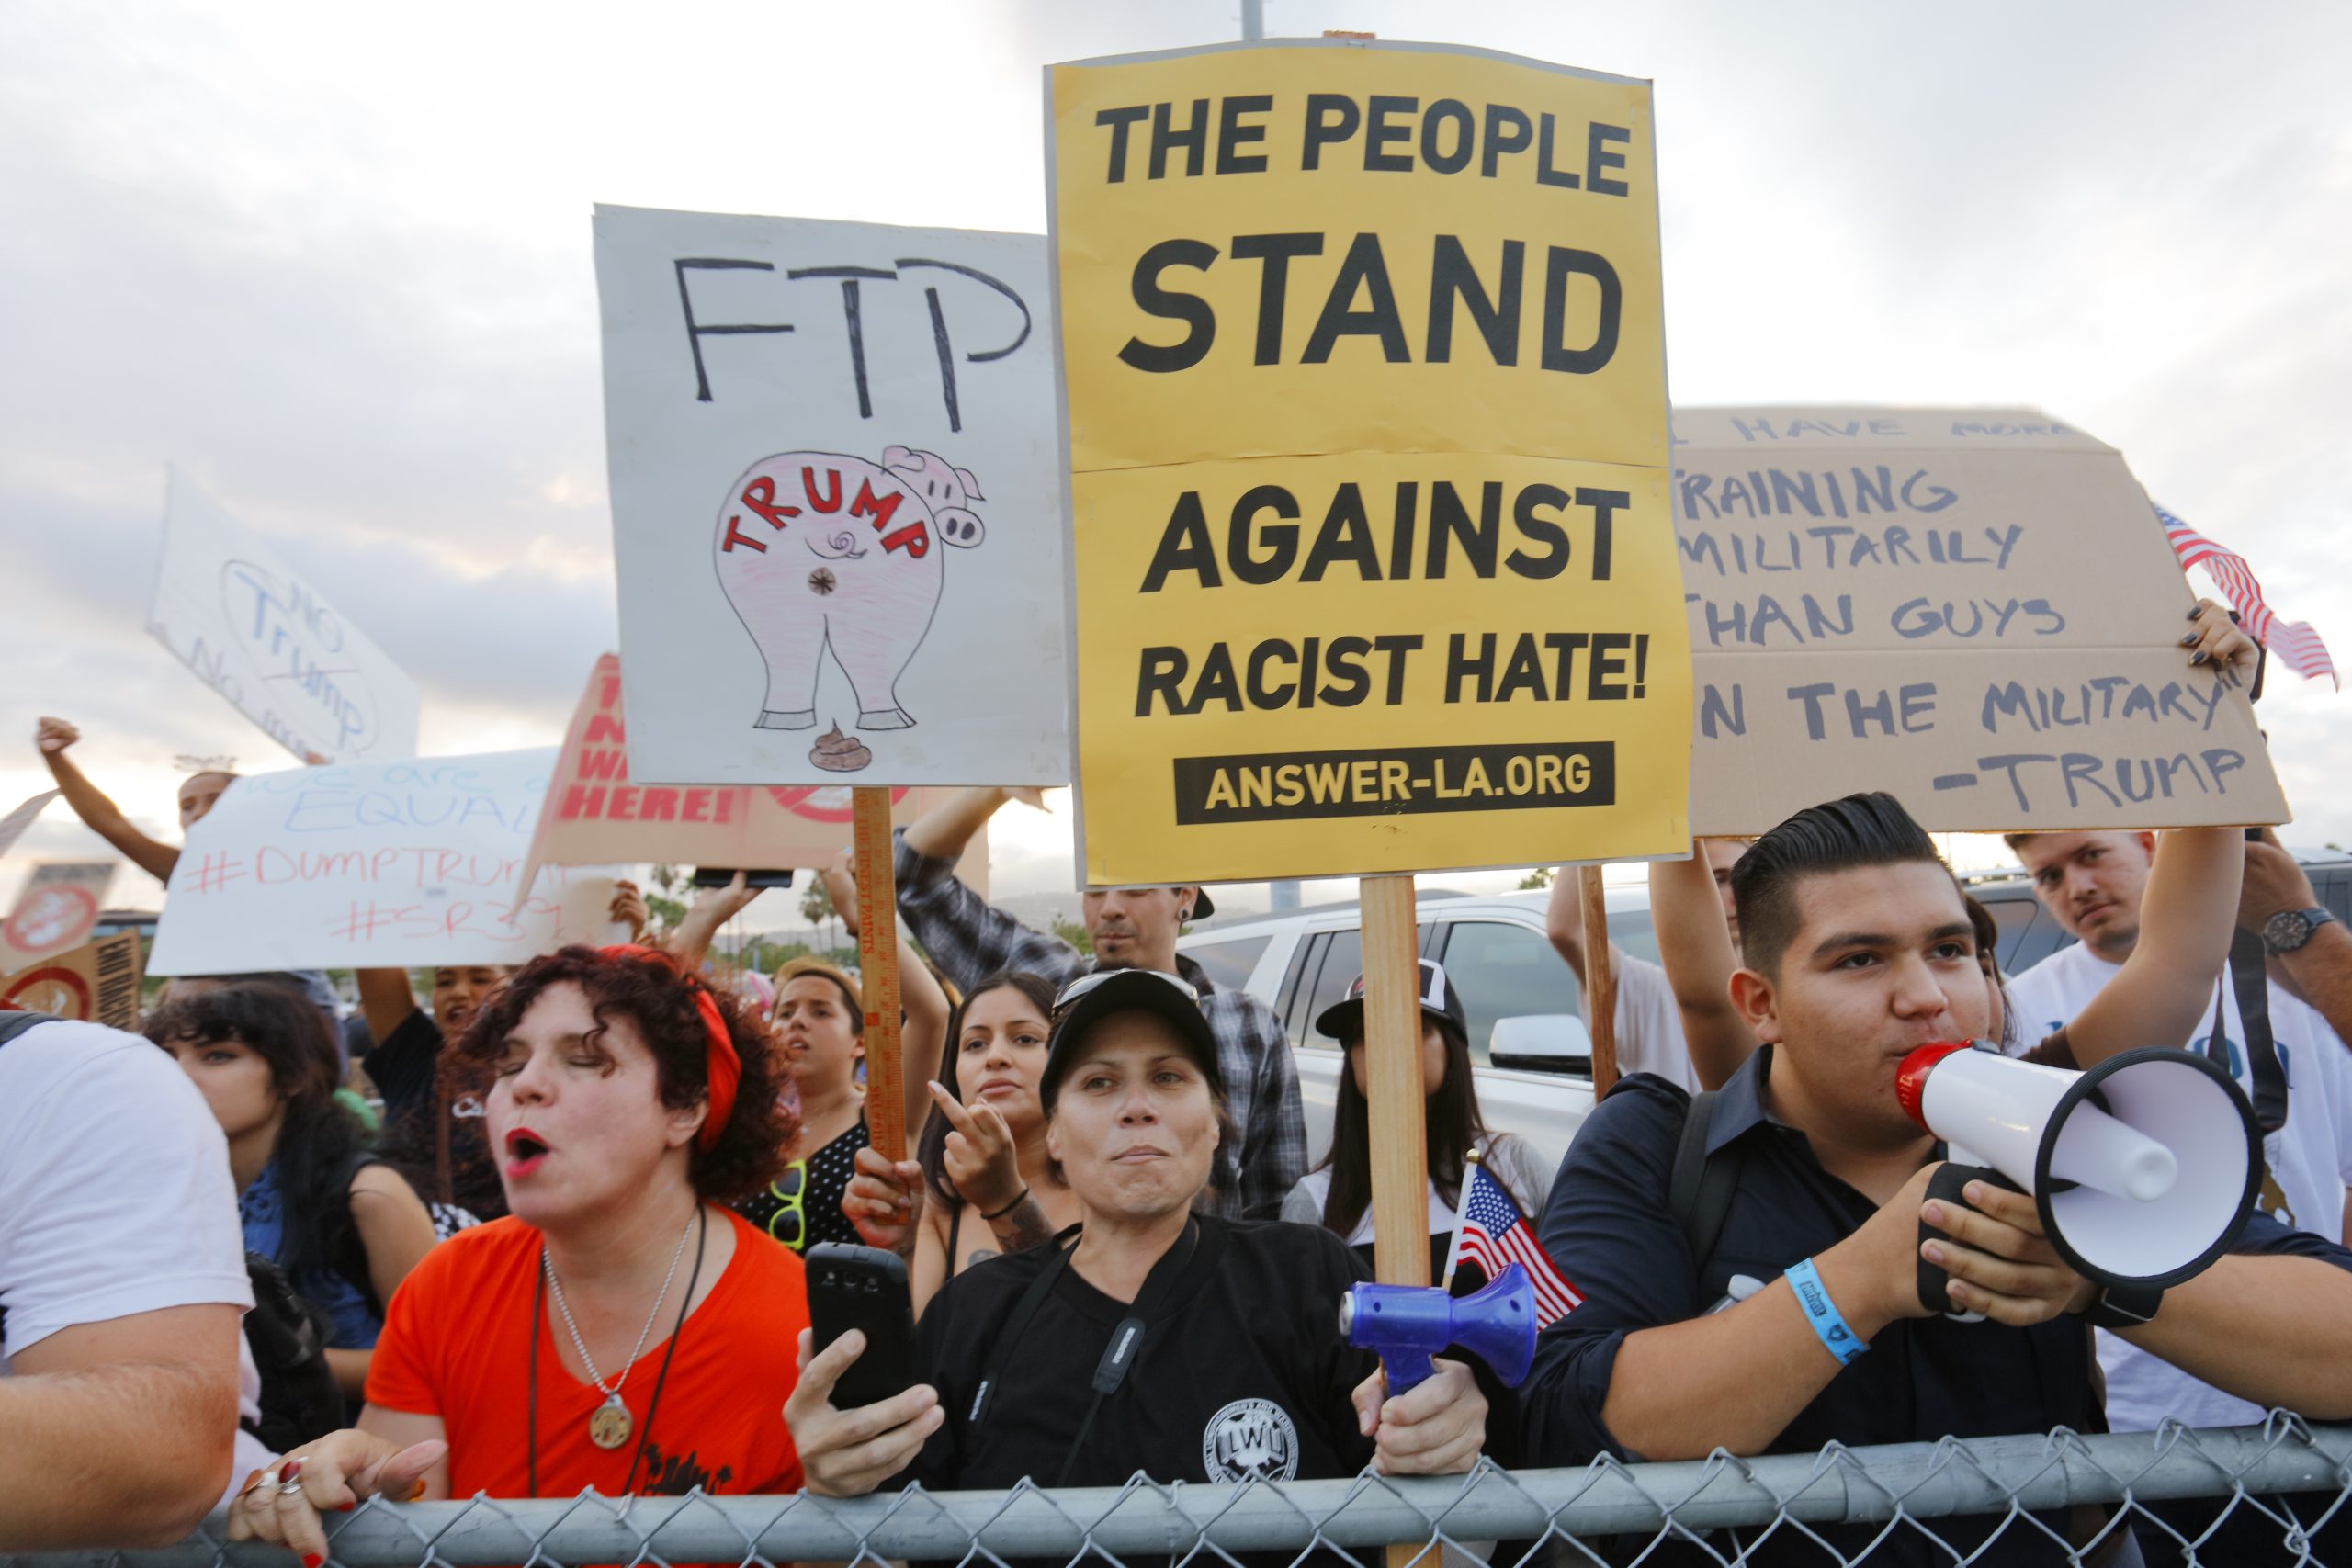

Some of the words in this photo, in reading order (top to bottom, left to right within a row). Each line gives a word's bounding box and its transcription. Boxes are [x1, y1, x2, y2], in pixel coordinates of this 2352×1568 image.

[1096, 95, 1273, 184] THE
[1301, 93, 1631, 197] PEOPLE
[1116, 232, 1623, 375] STAND
[674, 258, 1032, 433] FTP
[1731, 417, 1908, 441] HAVE
[722, 467, 929, 559] TRUMP
[1138, 480, 1630, 593] AGAINST
[1679, 525, 2024, 576] MILITARILY
[1685, 593, 1854, 646] HAN
[1891, 597, 2065, 639] GUYS
[1134, 634, 1423, 716] RACIST
[1444, 632, 1650, 705] HATE!
[1787, 682, 1937, 741] THE
[559, 785, 734, 824] HERE!
[1204, 754, 1591, 810] ANSWER-LA.ORG
[858, 849, 873, 899] FINEST
